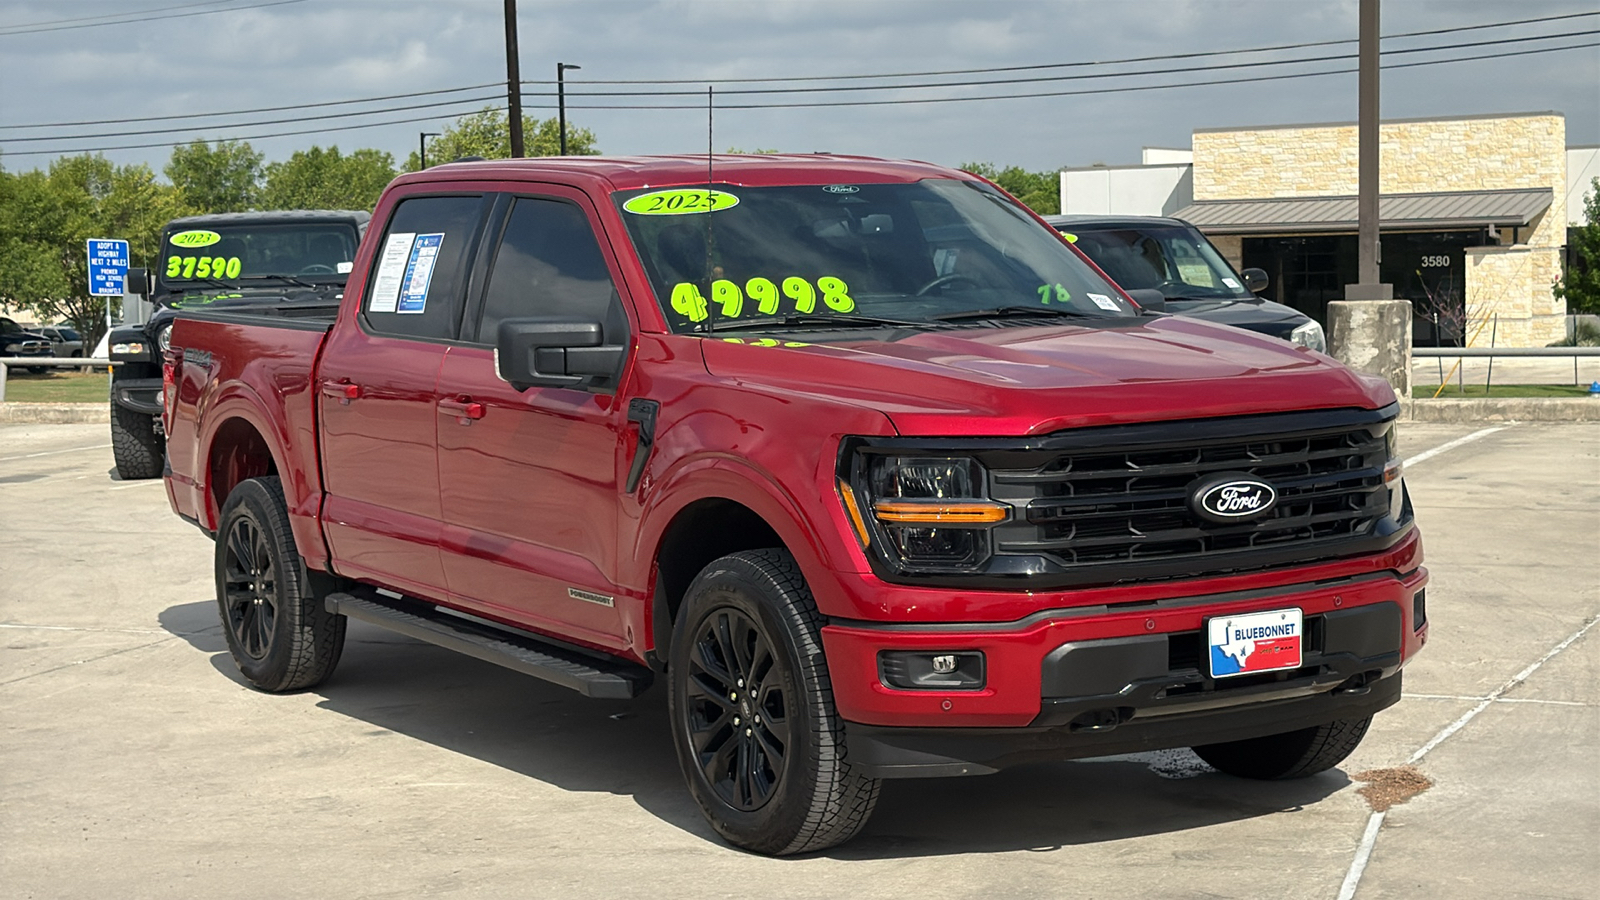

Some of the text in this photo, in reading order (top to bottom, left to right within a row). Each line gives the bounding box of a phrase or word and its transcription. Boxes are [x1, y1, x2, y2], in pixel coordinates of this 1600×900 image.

[647, 193, 720, 212] 2025
[97, 242, 114, 250] ADOPT
[179, 233, 212, 244] 2023
[97, 250, 119, 258] HIGHWAY
[1421, 255, 1450, 268] 3580
[91, 258, 104, 266] NEXT
[112, 258, 127, 267] MILES
[166, 256, 242, 279] 37590
[670, 276, 855, 323] 49998
[1217, 486, 1262, 511] Ford
[1235, 623, 1296, 641] BLUEBONNET
